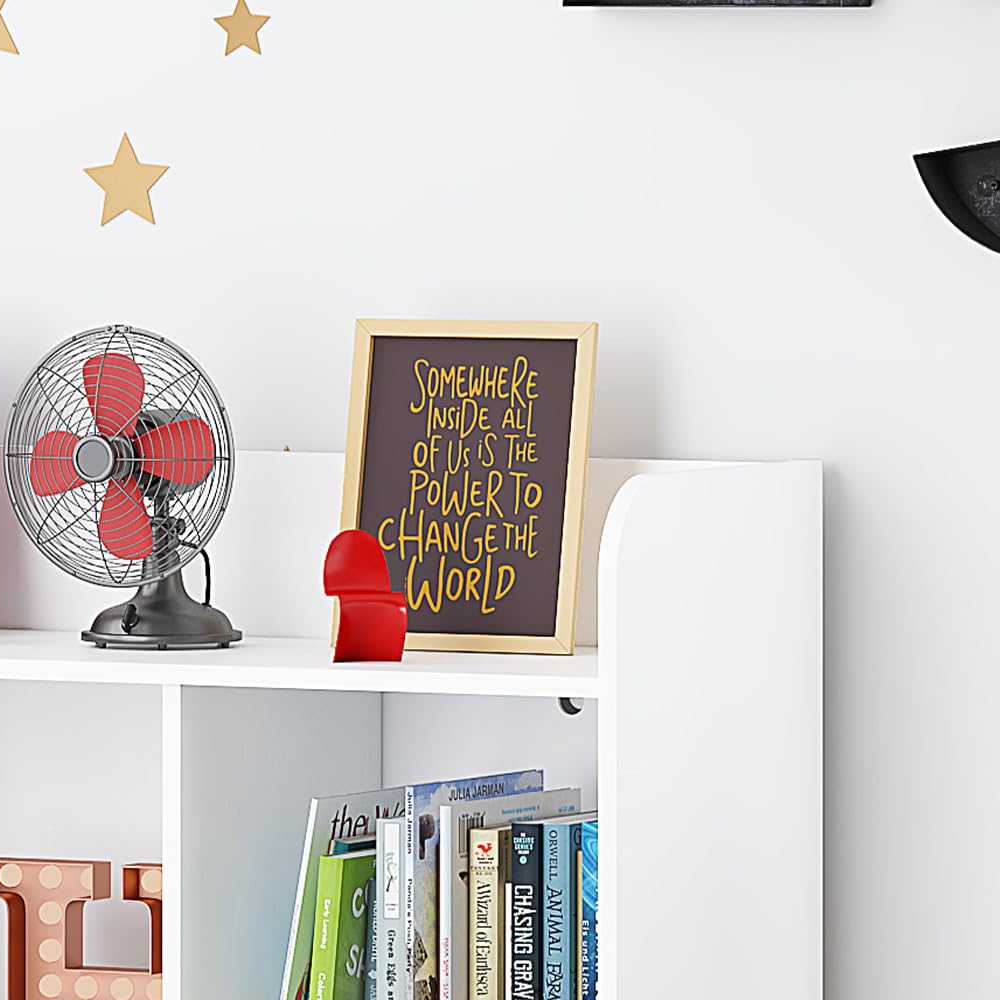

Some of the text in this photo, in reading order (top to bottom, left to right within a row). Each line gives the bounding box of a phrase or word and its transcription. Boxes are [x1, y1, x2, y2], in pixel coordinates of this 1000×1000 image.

[410, 356, 539, 413] SOMEWHERE
[501, 400, 537, 437] ALL
[413, 435, 442, 473] OF
[504, 434, 539, 469] THE
[409, 469, 543, 518] POWER TO
[378, 506, 539, 564] CHANGE THE
[406, 554, 517, 614] WORLD
[449, 783, 505, 801] JULIA JARMAN
[549, 829, 558, 881] ORWELL
[320, 899, 332, 950] Early Learning
[477, 889, 492, 928] Wizard
[513, 885, 536, 955] CHASING
[547, 885, 564, 957] ANIMAL
[387, 929, 397, 958] Green
[476, 932, 492, 944] of
[386, 962, 397, 988] Eggs
[476, 945, 492, 996] Earthsea
